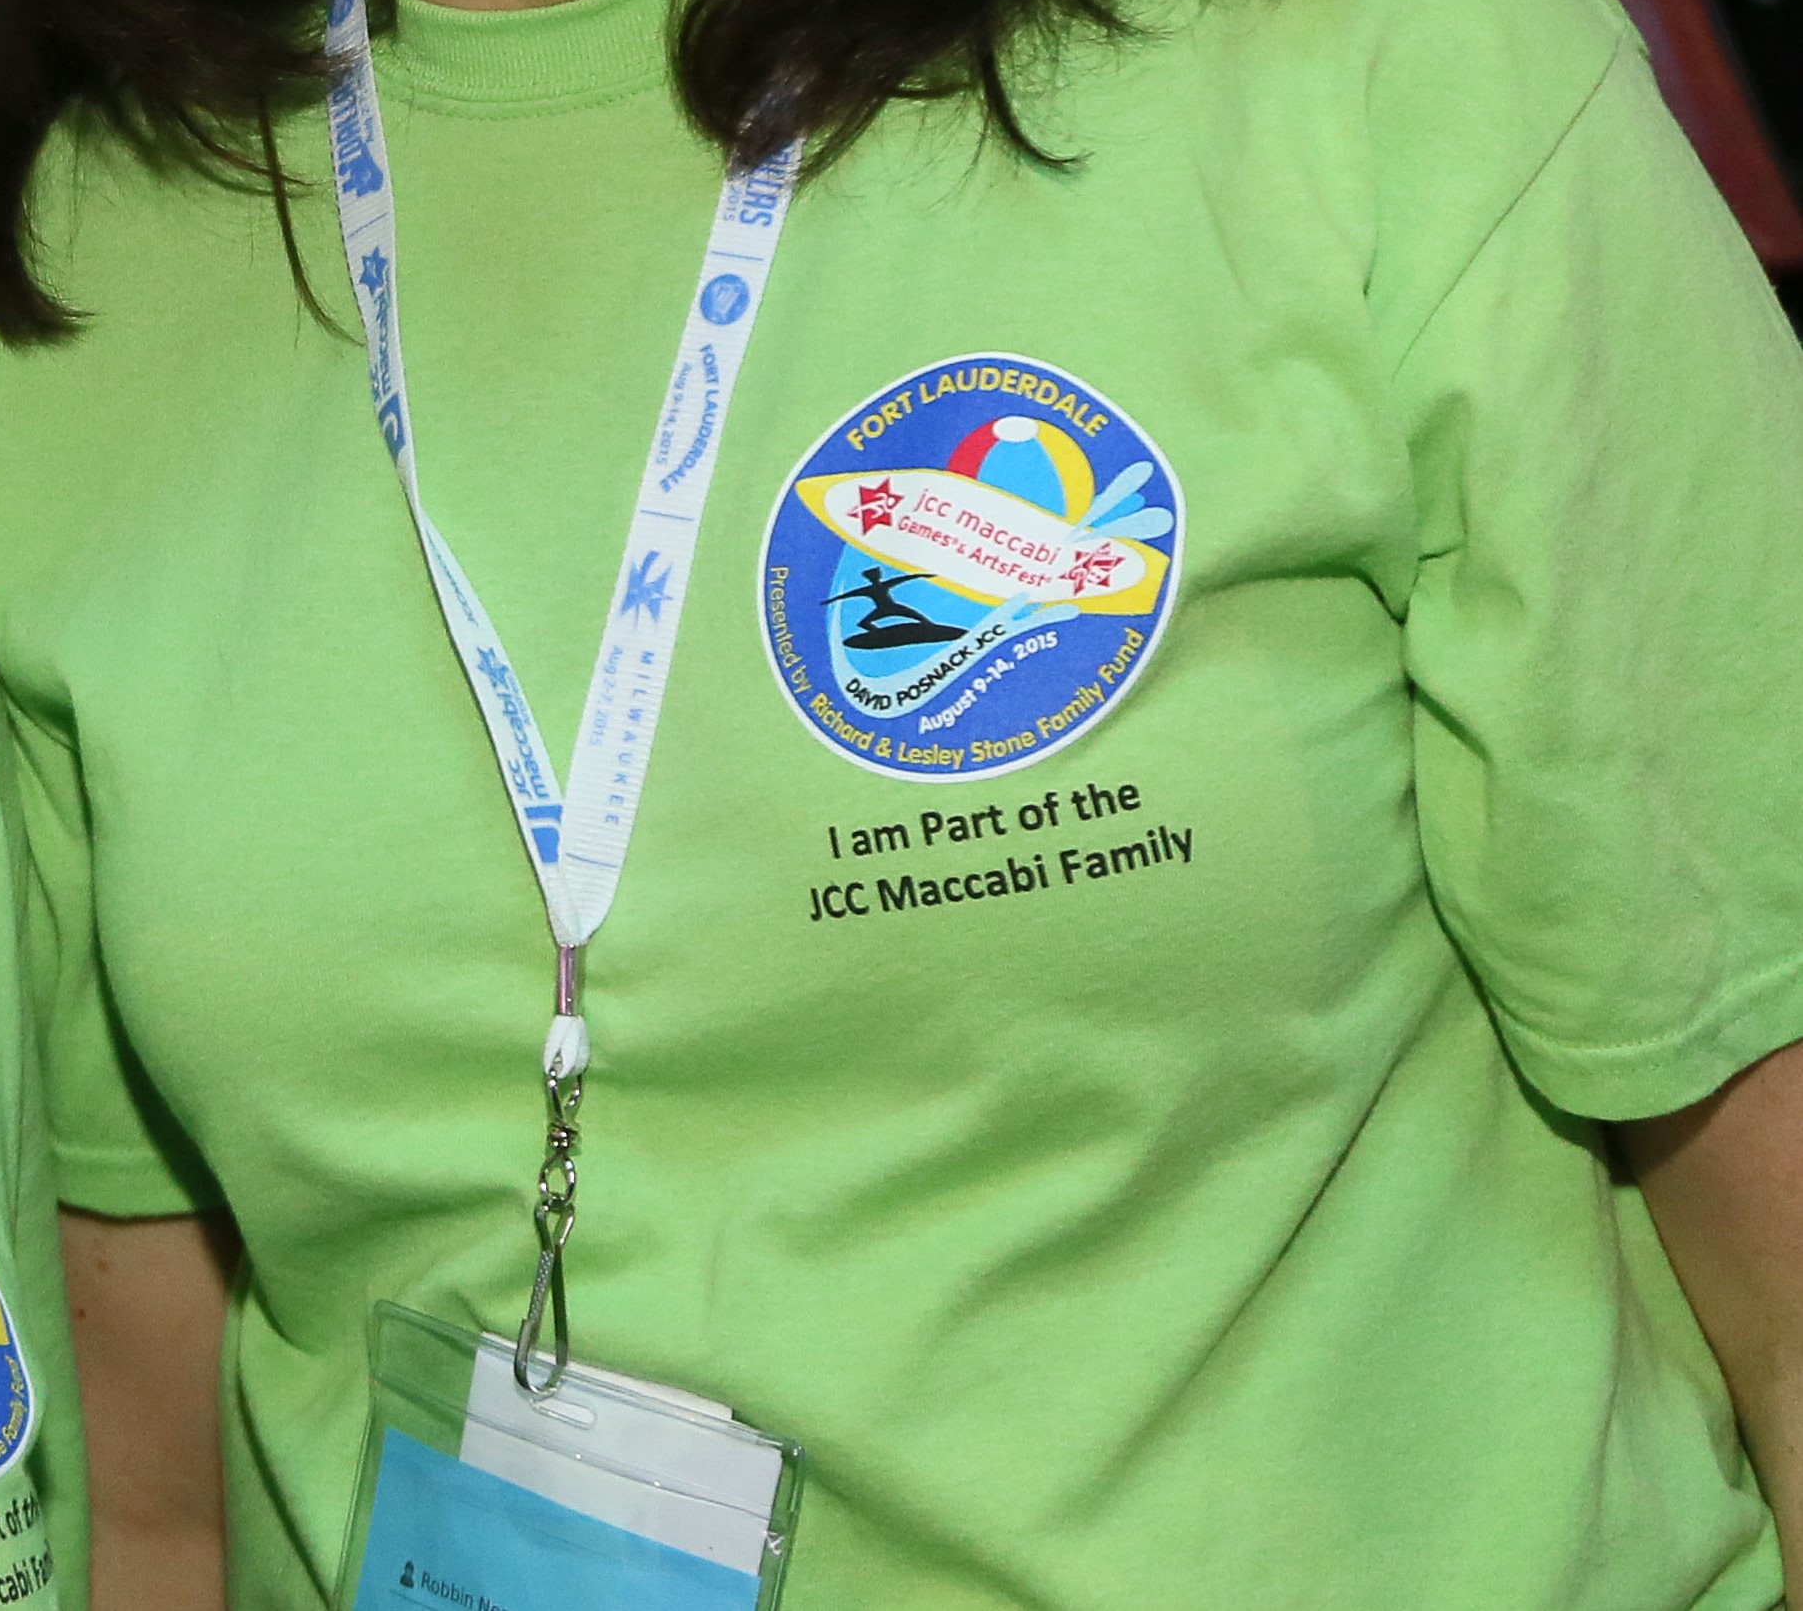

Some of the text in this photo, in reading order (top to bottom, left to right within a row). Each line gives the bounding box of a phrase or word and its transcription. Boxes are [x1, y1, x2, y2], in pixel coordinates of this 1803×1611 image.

[674, 362, 693, 395] Aug
[845, 366, 1110, 452] FORT LAUDERDALE
[654, 427, 676, 467] 2015
[659, 342, 719, 494] FORT LAUDERDALE
[913, 488, 1062, 566] jcc maccabi
[603, 644, 624, 675] Aug
[769, 565, 803, 669] Presented
[808, 691, 875, 751] Richard
[874, 736, 893, 759] &
[897, 741, 965, 770] Lesley
[969, 730, 1038, 763] Stone
[1035, 680, 1106, 739] Family
[1097, 626, 1146, 685] Fund
[845, 623, 1008, 711] DAVID POSNACK JCC
[918, 630, 1059, 735] August 9-14, 2015
[496, 689, 551, 800] maccabi
[589, 709, 609, 747] 2015
[828, 782, 1142, 860] I am Part of the
[809, 825, 1194, 922] JCC Maccabi Family
[4, 1496, 24, 1538] of
[420, 1570, 475, 1610] Robbin
